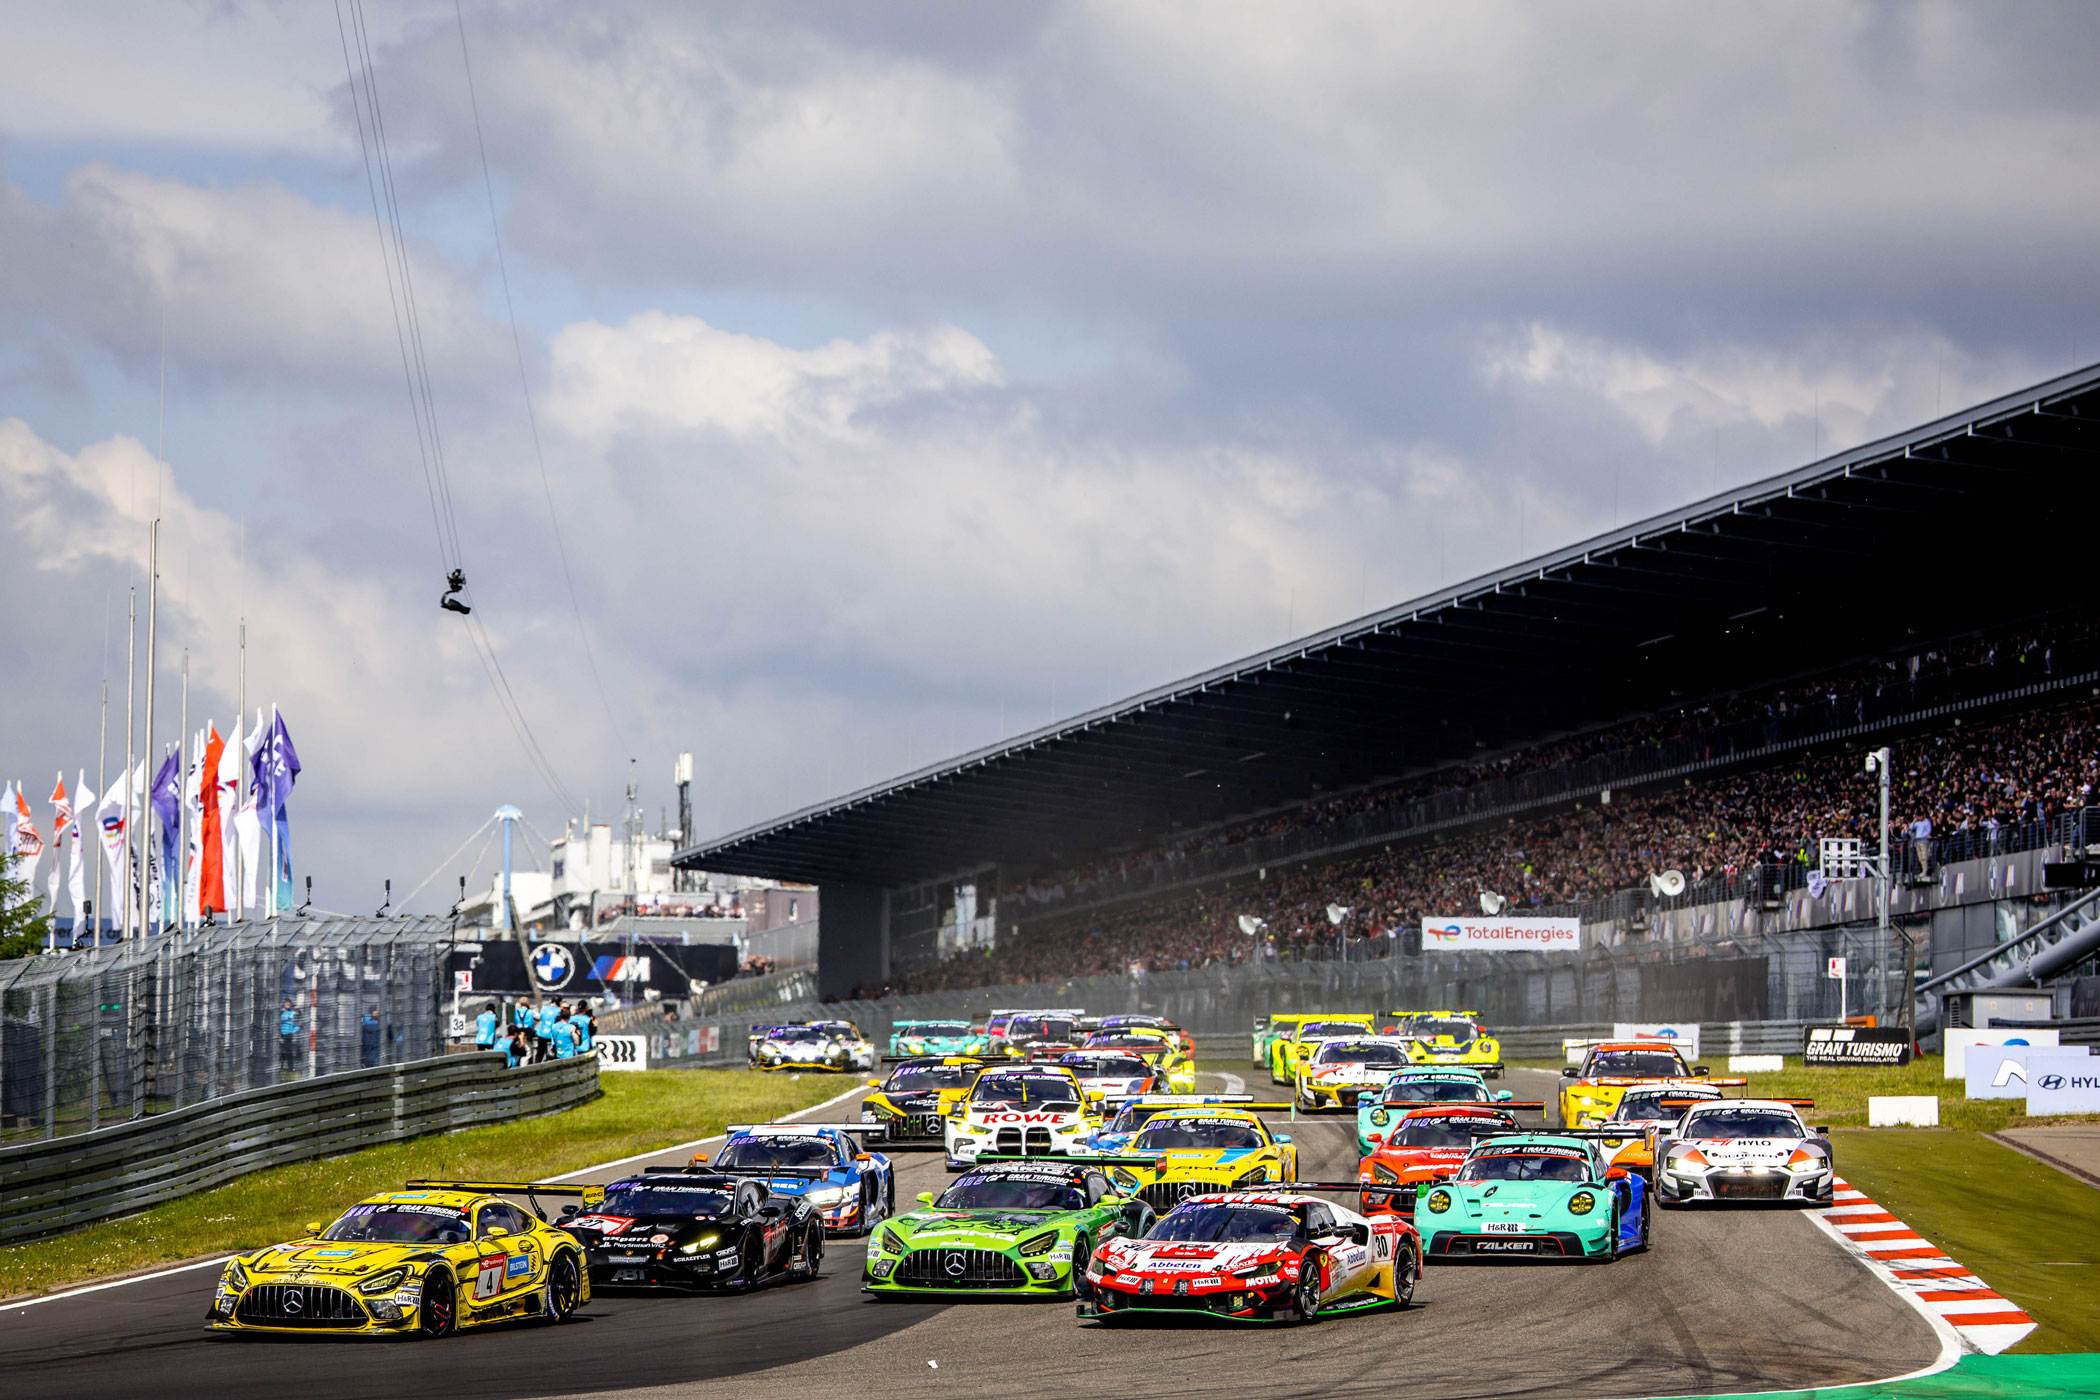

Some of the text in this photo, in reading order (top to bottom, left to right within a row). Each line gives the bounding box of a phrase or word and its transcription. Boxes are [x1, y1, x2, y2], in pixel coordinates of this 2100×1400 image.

[1465, 926, 1574, 943] TotalEnergies
[453, 1019, 464, 1031] 3a
[1806, 1041, 1903, 1057] GRAN TURISMO
[983, 1113, 1067, 1124] ROWE
[1007, 1173, 1032, 1181] GRAN
[1032, 1174, 1070, 1184] TURISMO
[398, 1204, 422, 1212] GRAN
[422, 1205, 461, 1217] TURISMO
[1375, 1234, 1388, 1258] 30
[1476, 1241, 1534, 1250] FALKEN
[673, 1254, 711, 1263] SCHAEFFLER
[1347, 1248, 1366, 1265] Abbelen
[509, 1260, 527, 1272] BILSTEIN
[611, 1268, 646, 1281] ABT
[1245, 1274, 1281, 1288] MOTUL
[486, 1271, 493, 1294] 4
